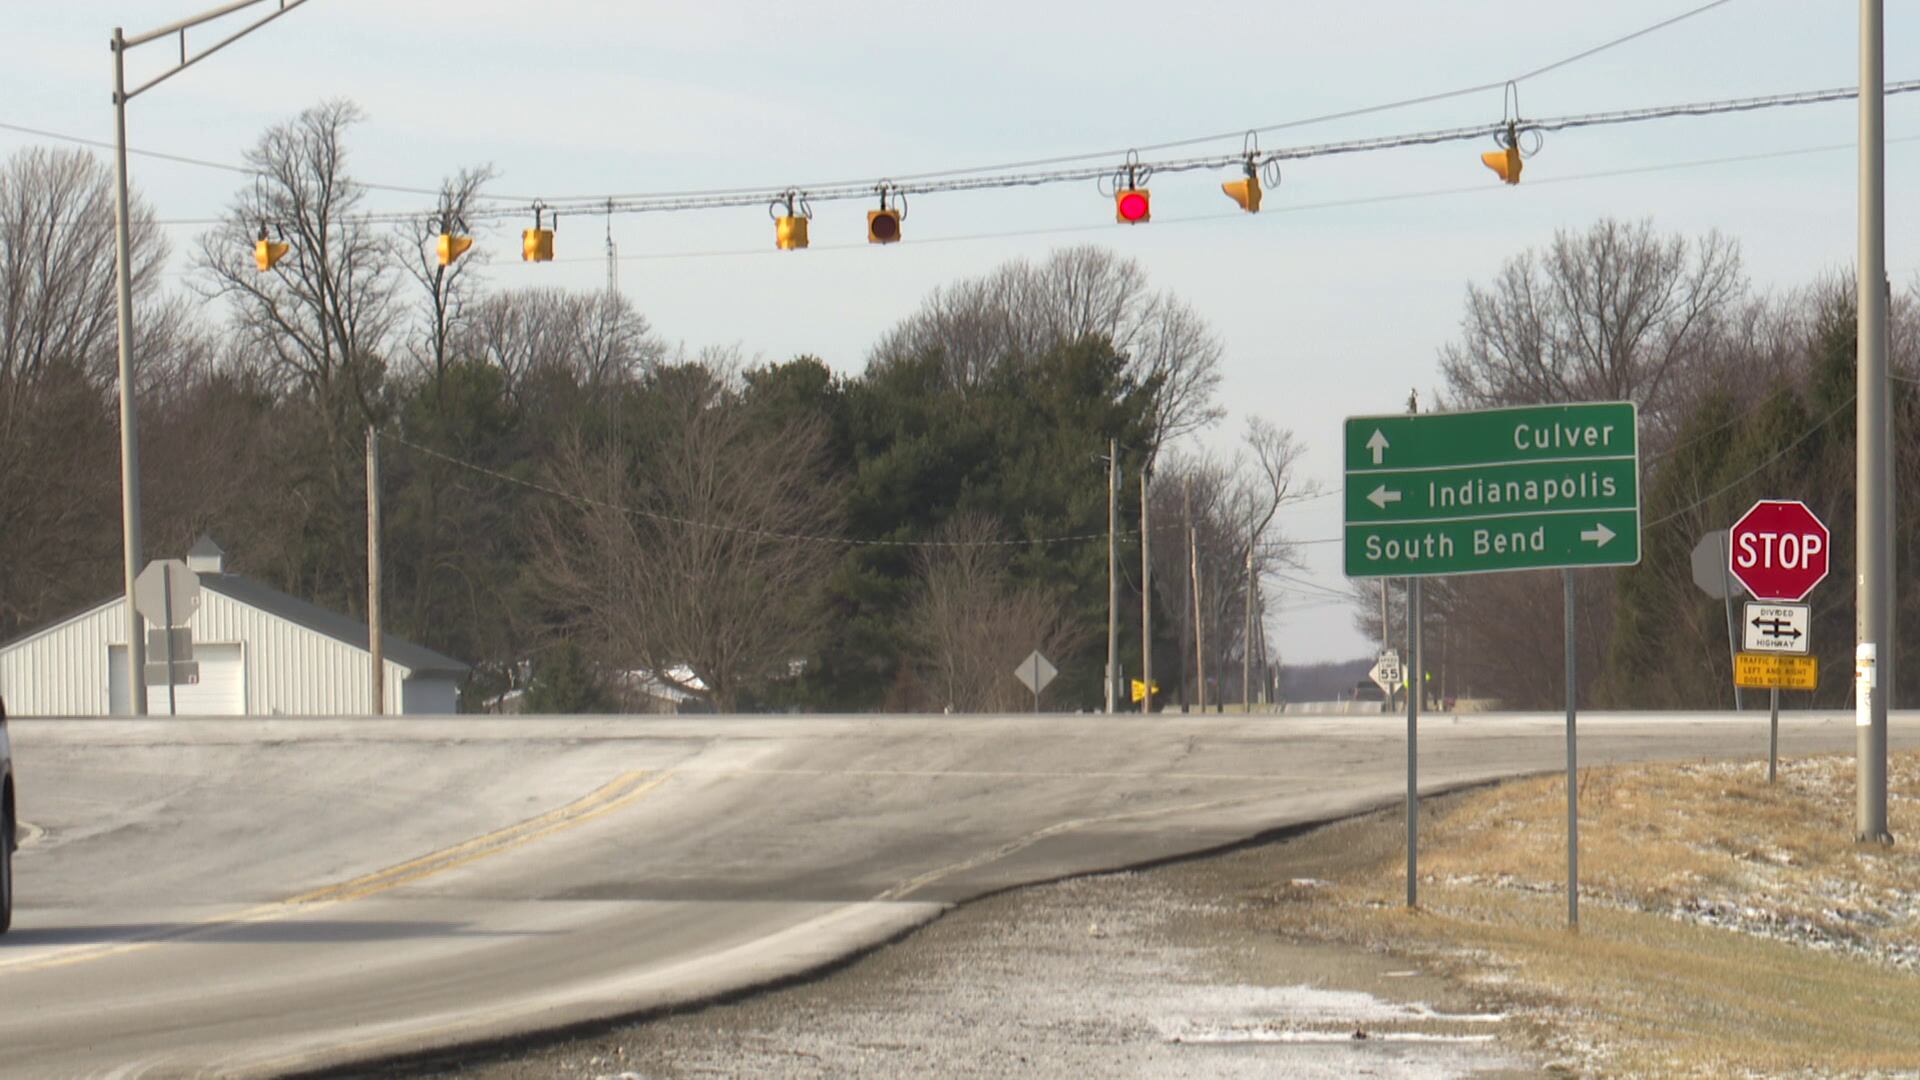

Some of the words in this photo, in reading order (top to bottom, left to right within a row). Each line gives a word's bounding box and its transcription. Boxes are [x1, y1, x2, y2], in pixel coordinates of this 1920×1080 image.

[1514, 423, 1614, 450] Culver
[1429, 471, 1617, 507] Indianapolis
[1365, 532, 1454, 560] South
[1473, 525, 1545, 555] Bend
[1737, 532, 1823, 569] STOP
[1760, 608, 1794, 617] DIVIDED
[1756, 639, 1795, 649] HIGHWAY
[1381, 668, 1398, 680] 55
[1743, 666, 1761, 674] LEFT
